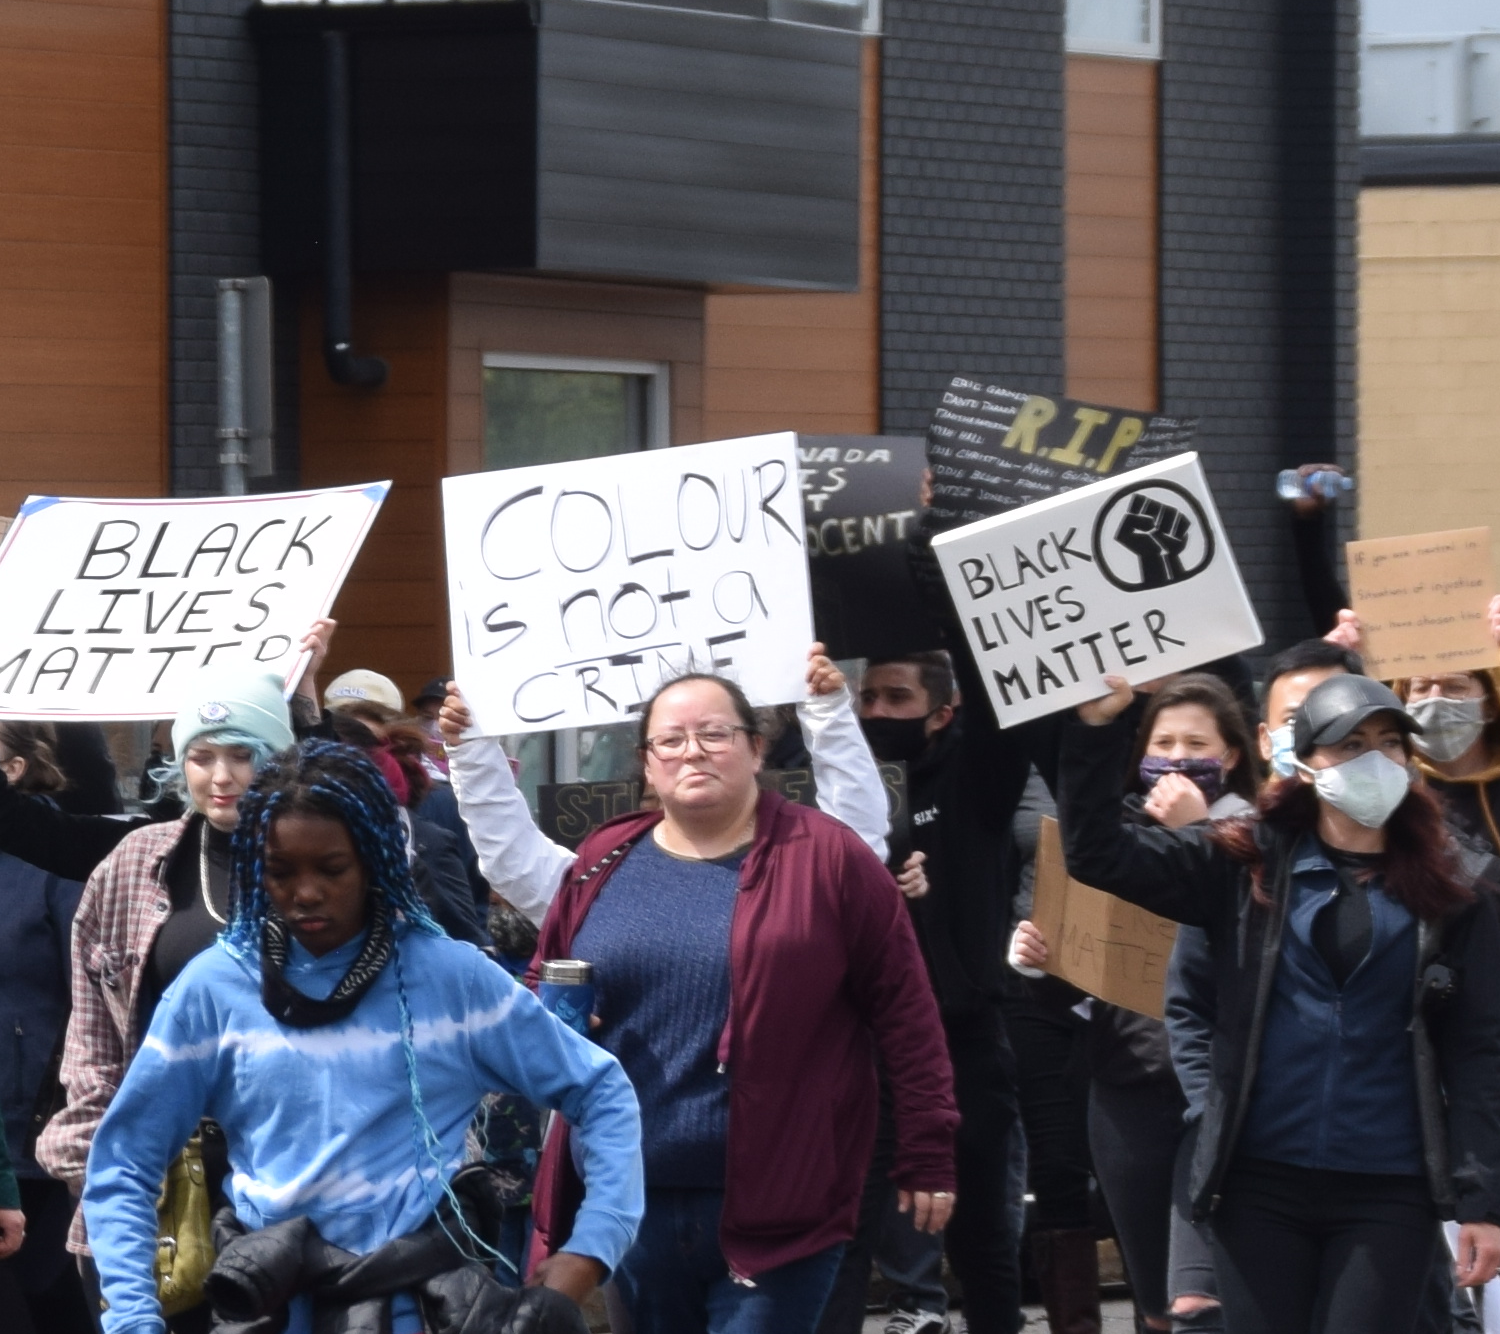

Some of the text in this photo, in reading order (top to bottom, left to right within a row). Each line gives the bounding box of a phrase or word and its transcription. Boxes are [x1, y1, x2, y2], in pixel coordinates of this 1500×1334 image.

[75, 515, 332, 581] BLACK
[481, 459, 801, 581] COLOUR
[958, 527, 1092, 601] BLACK
[34, 581, 287, 634] LIVES
[459, 568, 769, 657] is not a
[971, 585, 1086, 652] LIVES
[992, 608, 1187, 706] MATTER
